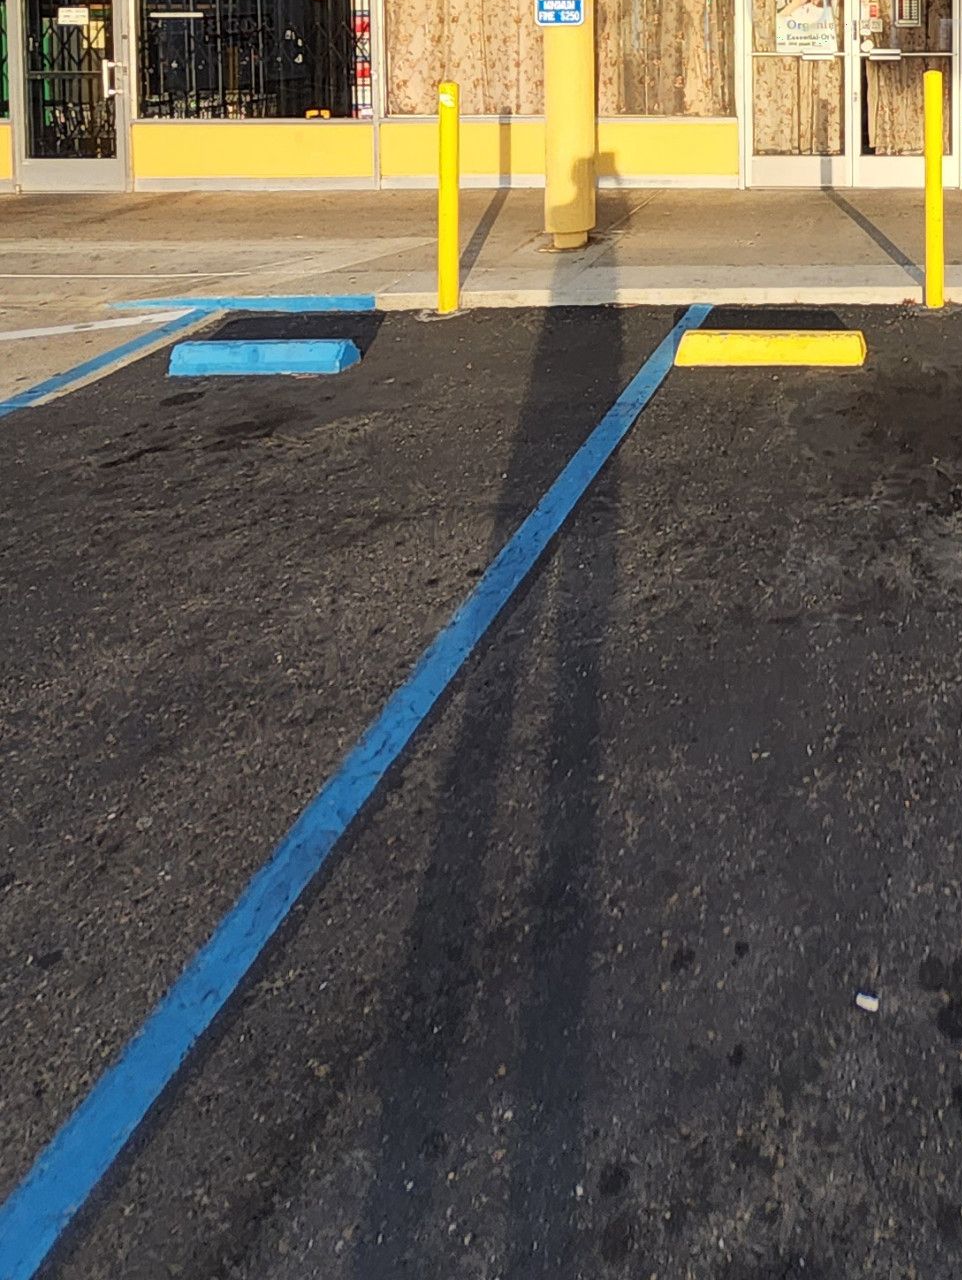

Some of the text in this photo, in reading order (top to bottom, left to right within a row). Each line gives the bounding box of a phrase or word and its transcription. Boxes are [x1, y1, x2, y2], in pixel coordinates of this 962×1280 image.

[543, 0, 576, 10] MINIMUM
[538, 10, 580, 22] FINE $250
